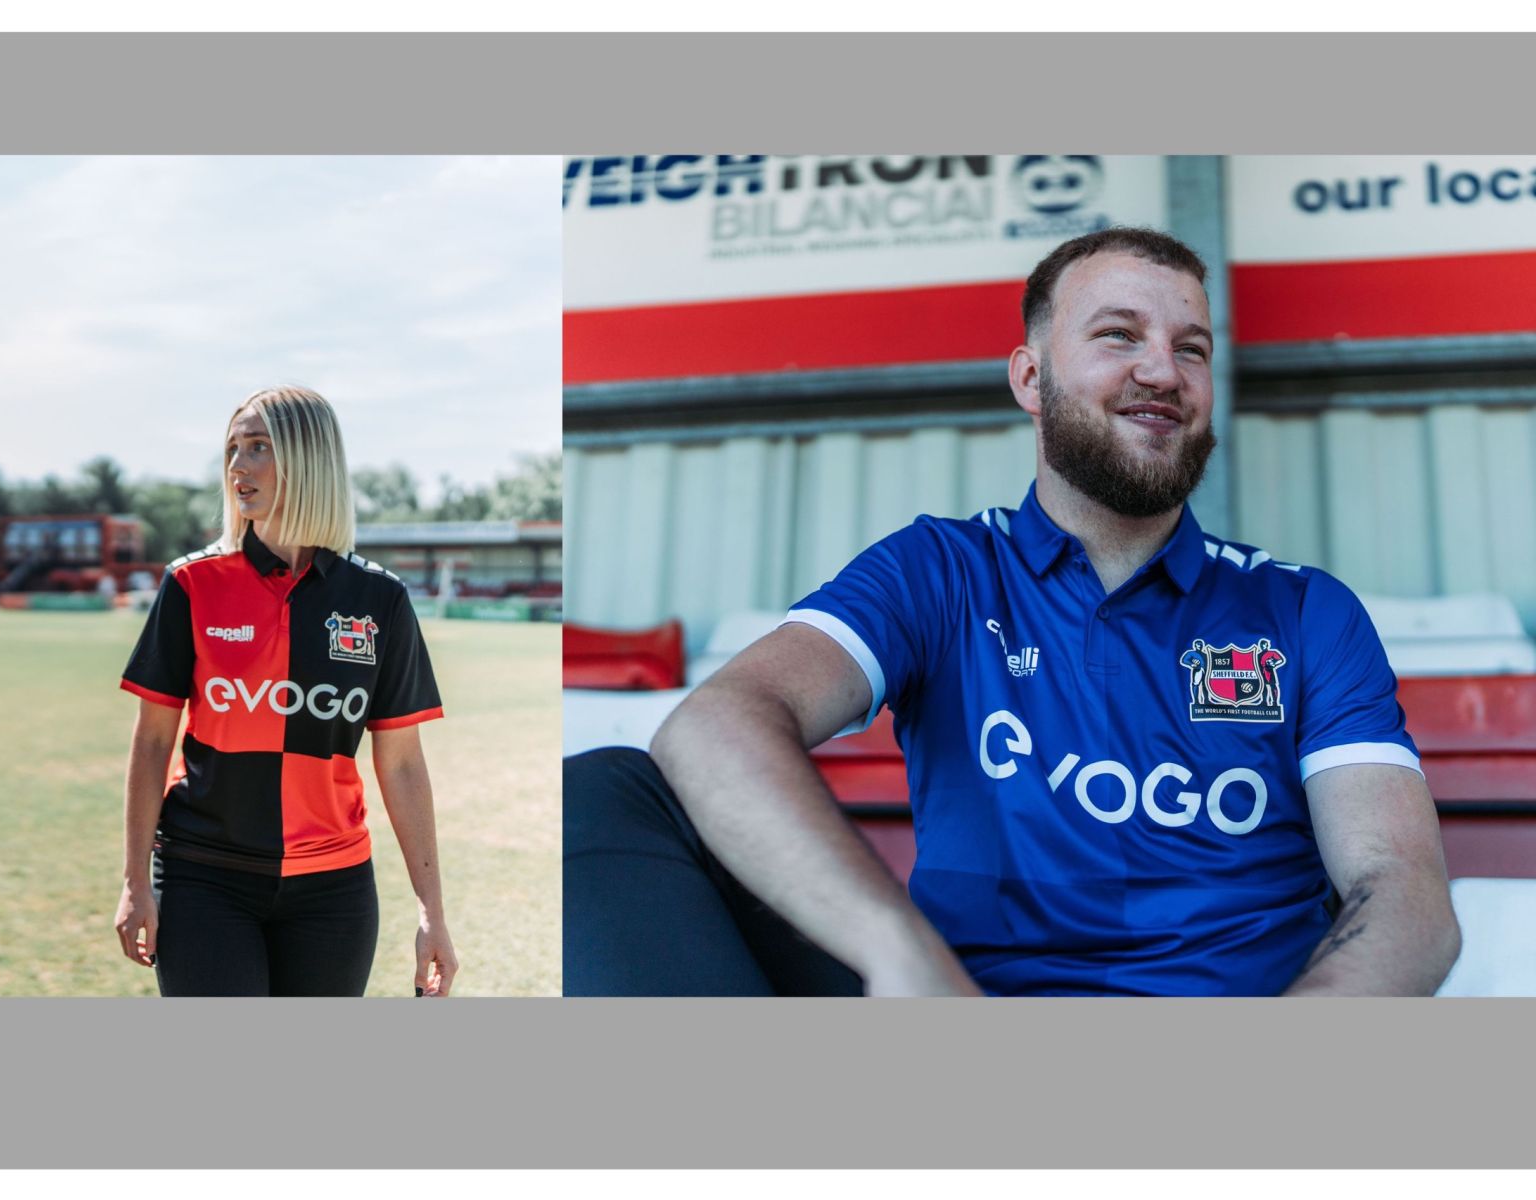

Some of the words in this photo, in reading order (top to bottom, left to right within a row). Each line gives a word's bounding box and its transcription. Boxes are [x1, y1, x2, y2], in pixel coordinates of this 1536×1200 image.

[1294, 177, 1402, 214] our
[1426, 162, 1536, 204] loc
[206, 625, 254, 640] capelli
[986, 619, 1040, 669] celli
[1214, 658, 1230, 666] 1857
[1212, 670, 1245, 678] SHEFFIELD
[1241, 708, 1265, 716] FOOTBALL
